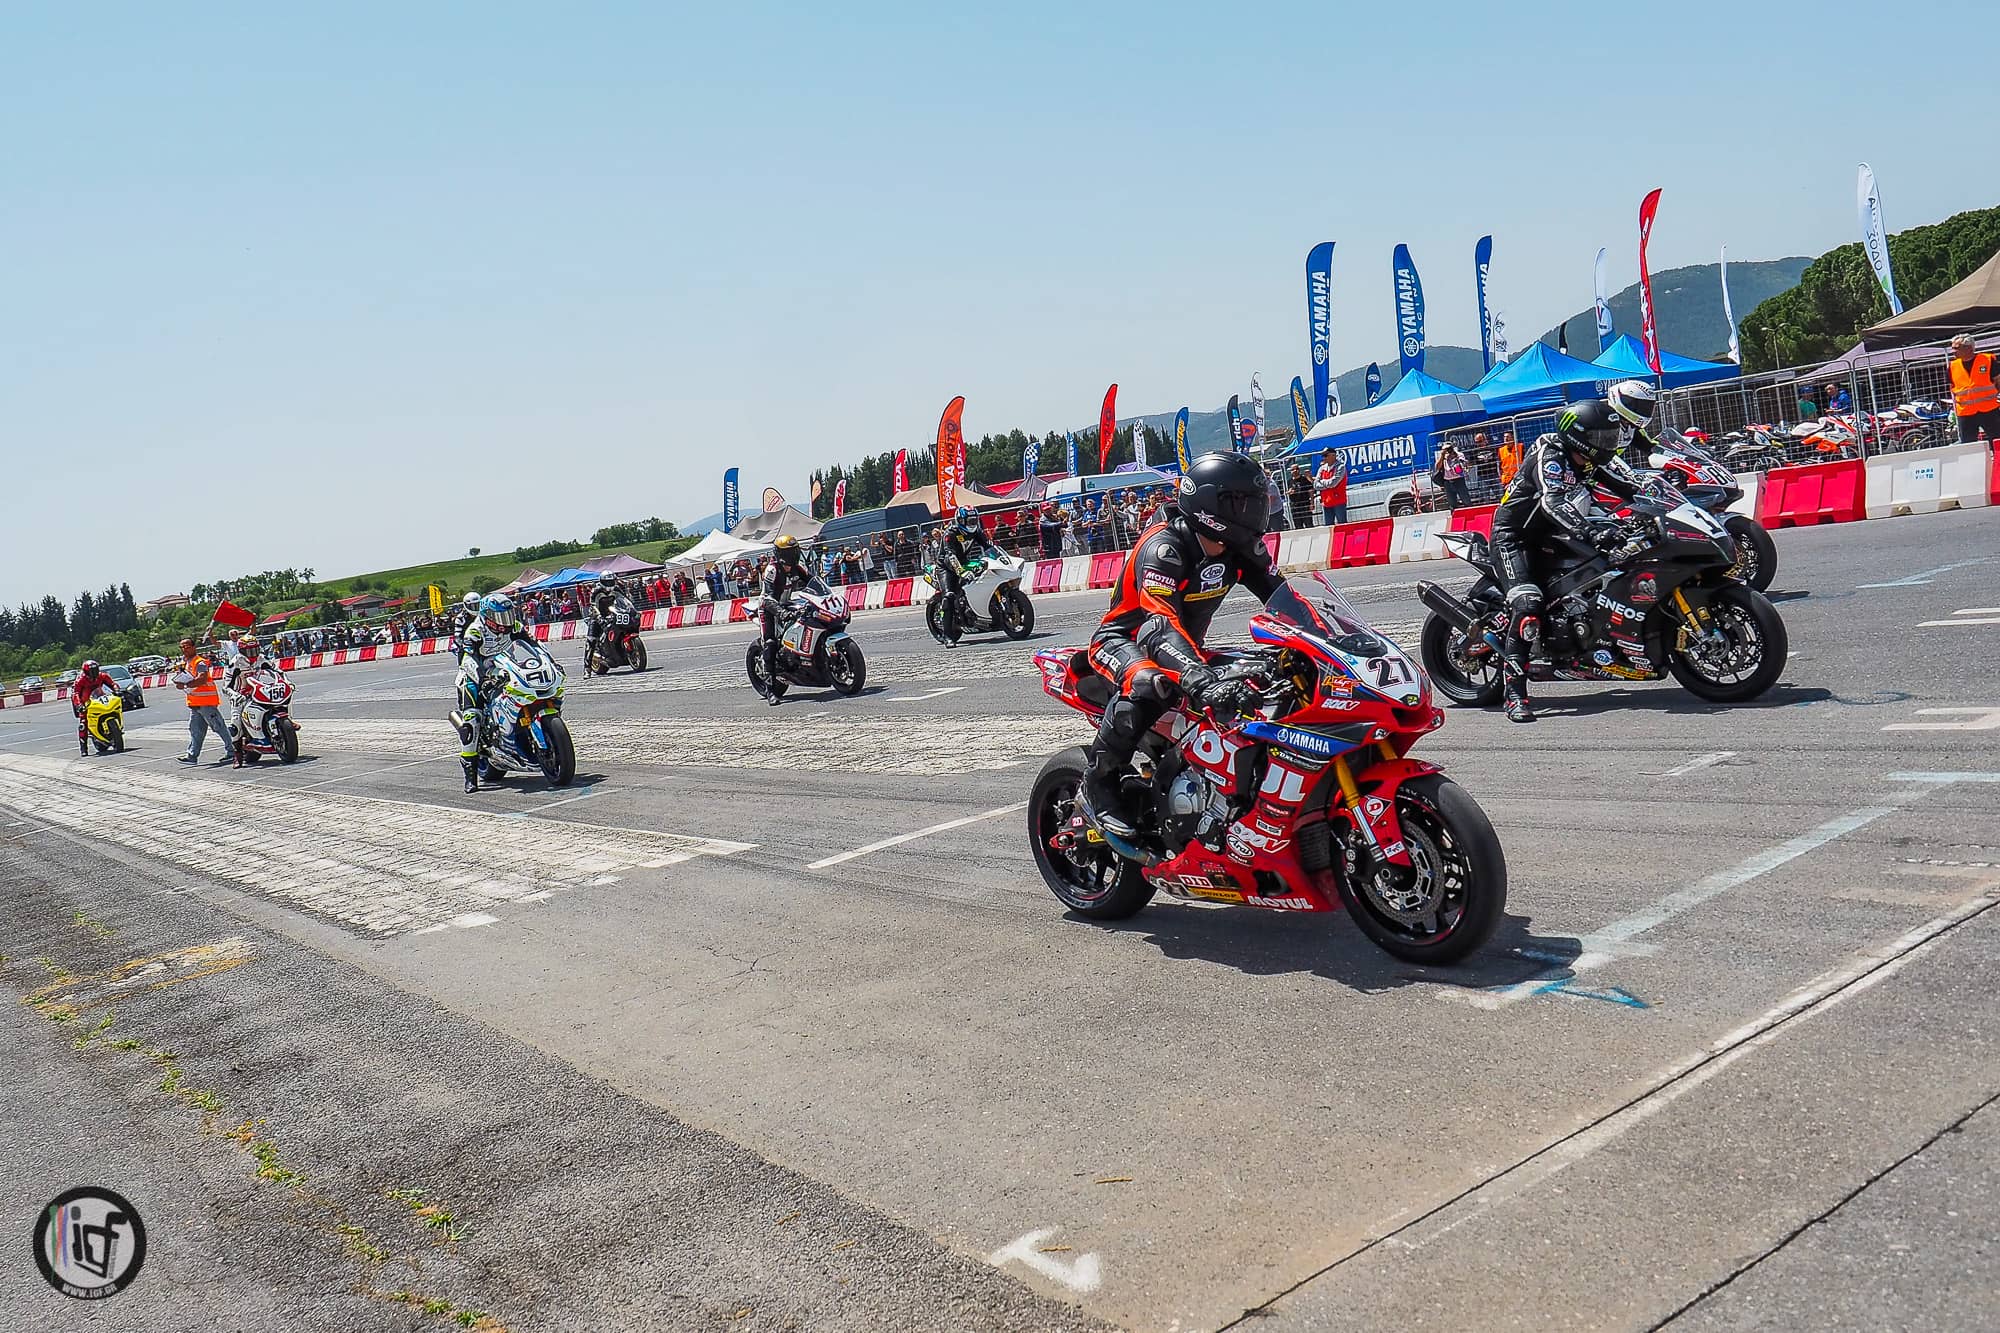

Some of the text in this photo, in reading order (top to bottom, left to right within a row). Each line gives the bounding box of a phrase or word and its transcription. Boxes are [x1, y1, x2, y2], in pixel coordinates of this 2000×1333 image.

[1312, 271, 1327, 343] YAMAHA
[1398, 267, 1418, 337] YAMAHA
[1350, 435, 1417, 467] YAMAHA
[1350, 458, 1413, 475] ACING
[727, 480, 737, 518] YAMAHA
[1688, 509, 1723, 535] 1
[1145, 572, 1177, 587] MOTUL
[1596, 594, 1647, 622] ENEOS
[1366, 656, 1414, 690] 27
[268, 684, 286, 700] 156
[1288, 732, 1331, 754] YAMAHA
[1181, 875, 1213, 888] DID
[1248, 895, 1314, 910] MOTUL
